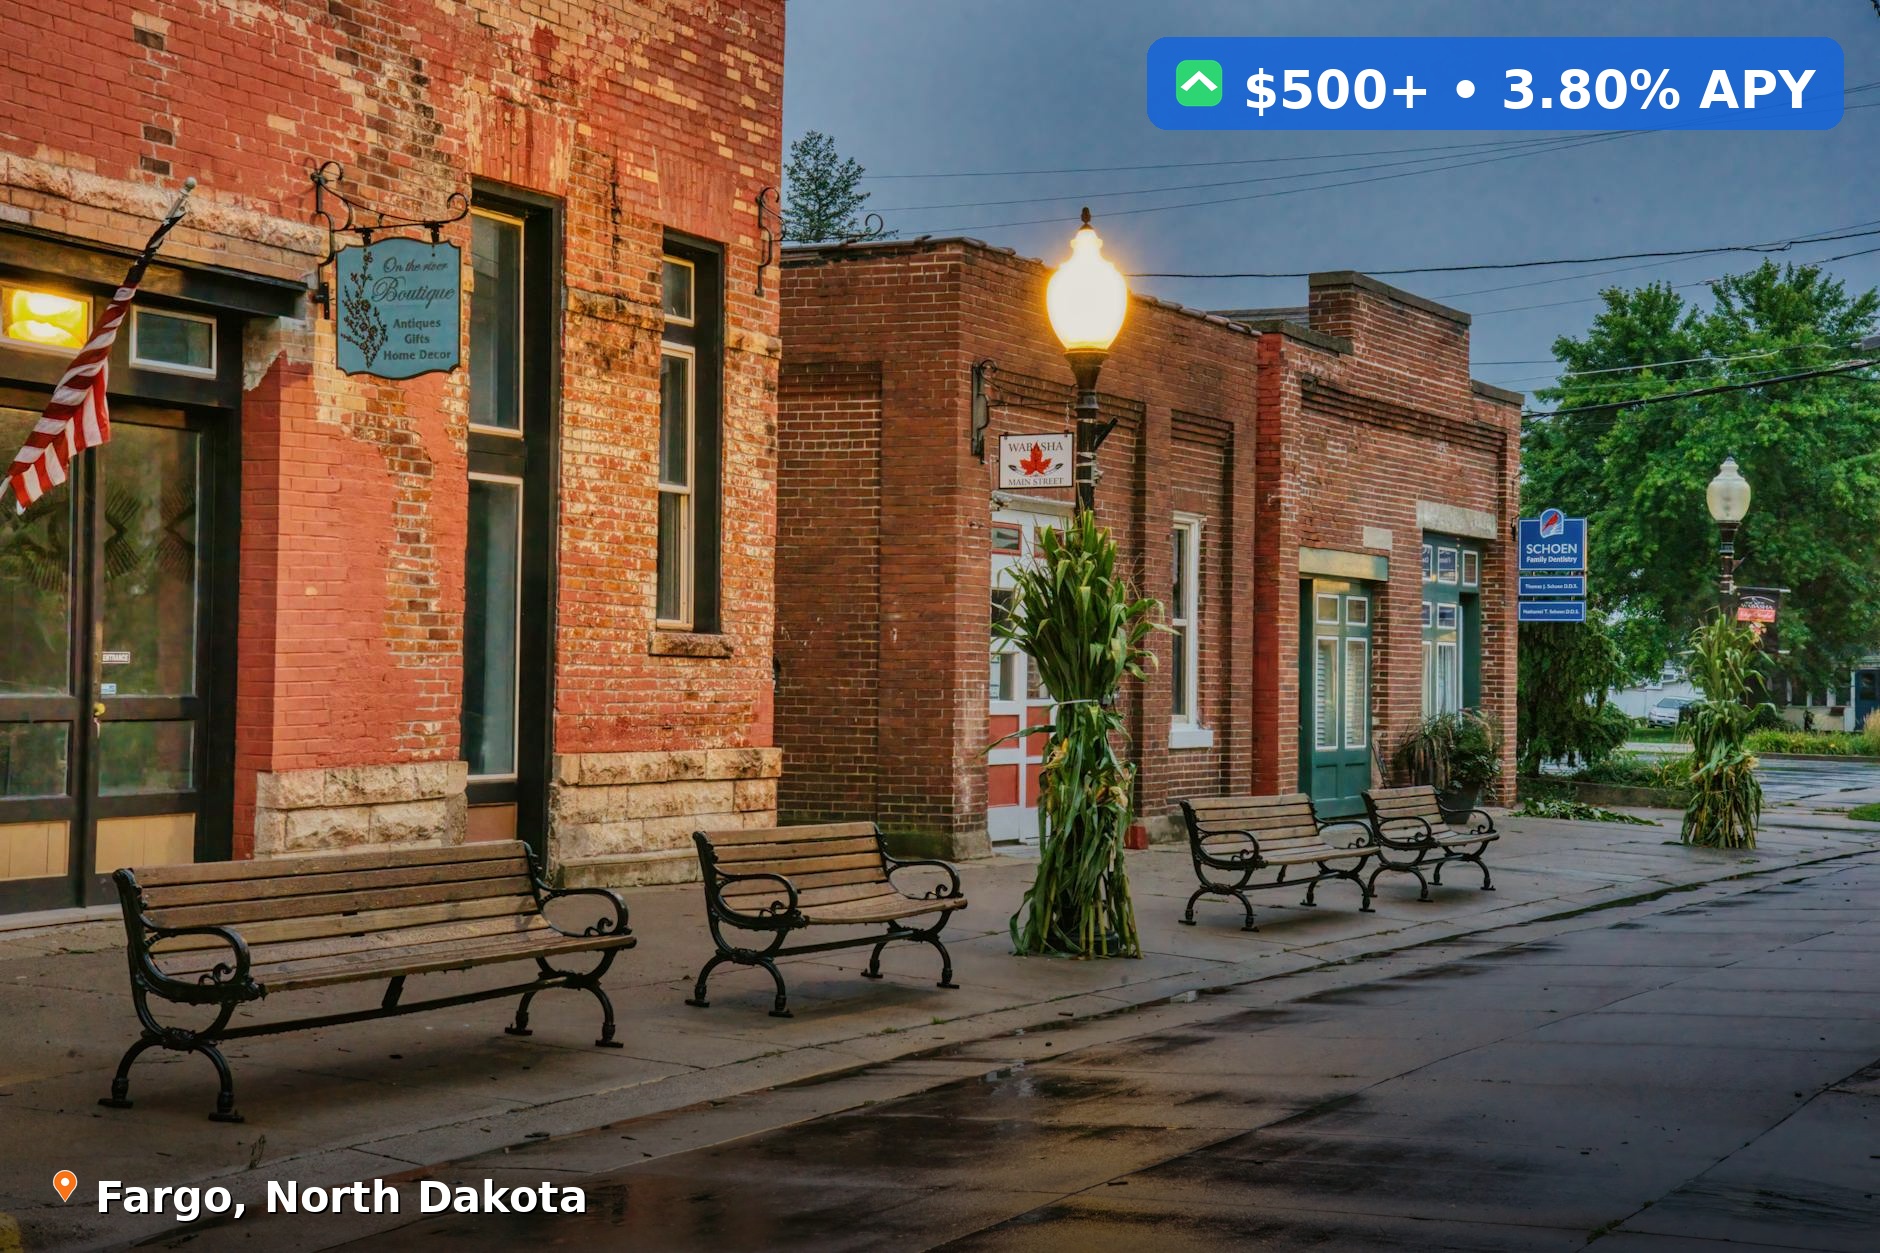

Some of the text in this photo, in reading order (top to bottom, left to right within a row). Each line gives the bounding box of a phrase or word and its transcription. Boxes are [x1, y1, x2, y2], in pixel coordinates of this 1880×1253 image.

[383, 257, 449, 273] On the river
[371, 276, 455, 309] Boutique
[393, 318, 441, 330] Antiques
[404, 333, 430, 344] Gifts
[383, 349, 452, 361] Home Decor
[1008, 477, 1065, 487] MAIN STREET
[1526, 543, 1577, 554] SCHOEN
[1526, 556, 1578, 564] Family Dentistry
